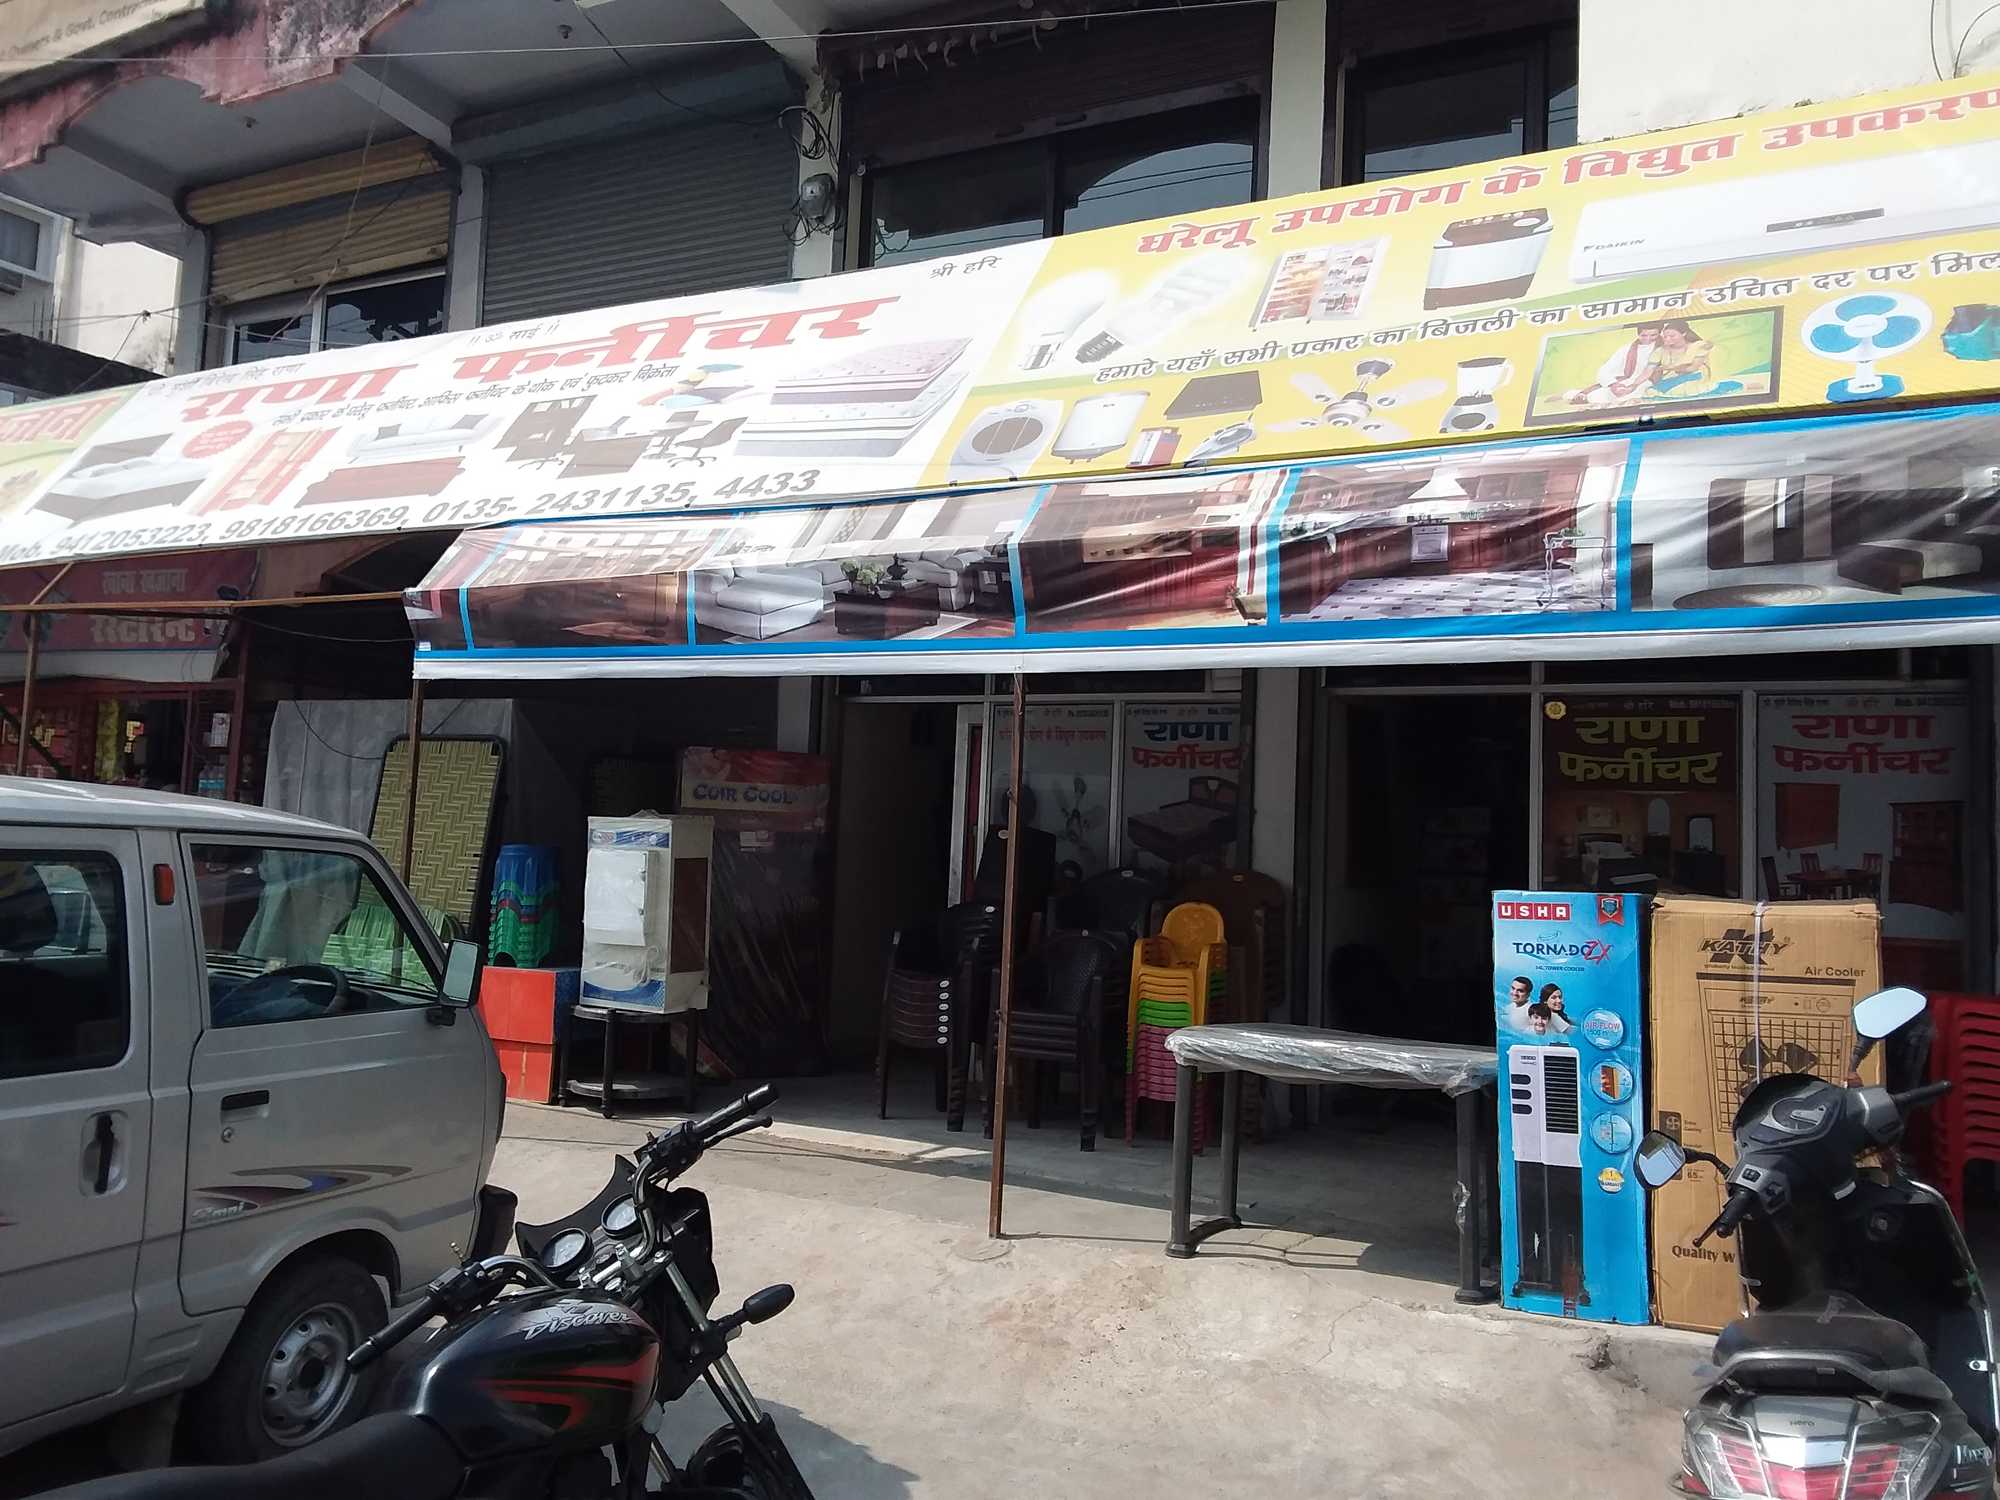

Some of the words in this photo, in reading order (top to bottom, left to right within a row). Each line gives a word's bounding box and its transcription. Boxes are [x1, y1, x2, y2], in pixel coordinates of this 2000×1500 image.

[1137, 217, 1260, 253] घरेलू
[1272, 181, 1470, 233] उपयोग
[1483, 165, 1548, 195] के
[1564, 133, 1744, 185] विद्युत
[930, 262, 955, 279] श्री
[963, 256, 1002, 274] हरि
[1096, 360, 1156, 382] हमारे
[1165, 348, 1216, 372] यहाँ
[1224, 341, 1281, 364] सभी
[1291, 335, 1363, 355] प्रकार
[1372, 328, 1409, 347] का
[1420, 309, 1518, 339] बिजली
[1531, 307, 1570, 325] का
[1582, 291, 1692, 319] सामान
[1706, 278, 1799, 303] उचित
[1812, 271, 1854, 290] दर
[1868, 263, 1917, 282] पर
[181, 364, 418, 422] राणा
[453, 296, 900, 383] फर्नीचर
[528, 378, 559, 393] थोक
[560, 373, 588, 391] एवं
[581, 371, 632, 392] फुटकर
[56, 523, 210, 554] 9412053223,
[223, 506, 409, 540] 9818166369,
[422, 496, 517, 525] 0135-
[525, 481, 699, 517] 2431135,
[714, 469, 821, 500] 4433
[1144, 720, 1232, 742] राणा
[1575, 716, 1705, 743] राणा
[1791, 714, 1937, 740] राणा
[1558, 746, 1723, 784] फर्नीचर
[1772, 743, 1957, 775] फर्नीचर
[694, 784, 737, 802] COIR
[1500, 903, 1568, 919] USHA
[1804, 966, 1822, 976] Air
[1825, 967, 1866, 977] Cooler
[1672, 1245, 1718, 1263] Quality
[520, 1310, 631, 1341] Discover
